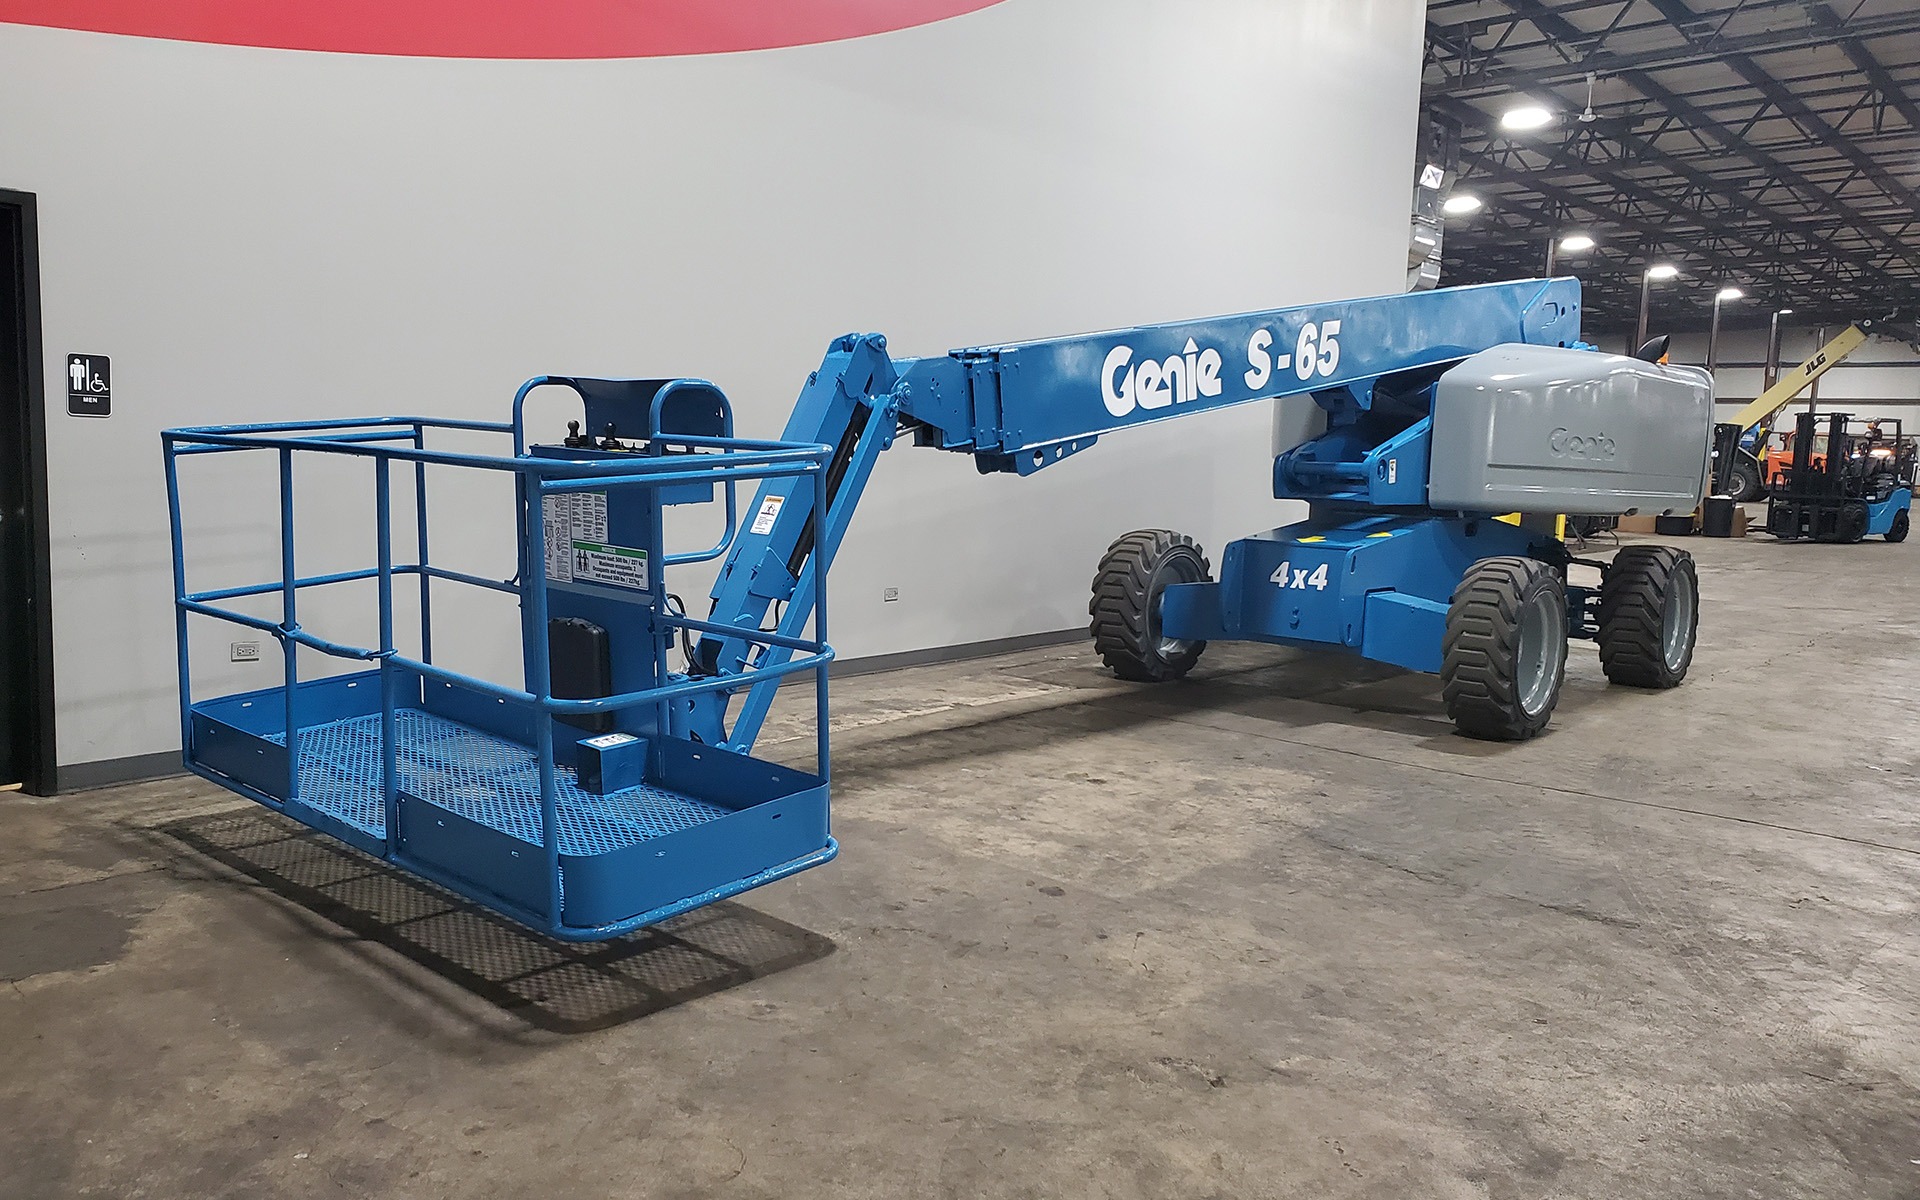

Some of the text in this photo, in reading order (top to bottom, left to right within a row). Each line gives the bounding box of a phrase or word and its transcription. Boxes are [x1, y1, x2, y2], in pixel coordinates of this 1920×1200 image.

[1101, 337, 1222, 417] Genie
[1805, 352, 1827, 376] JLG
[1547, 427, 1616, 461] Genie
[1270, 562, 1328, 590] 4x4
